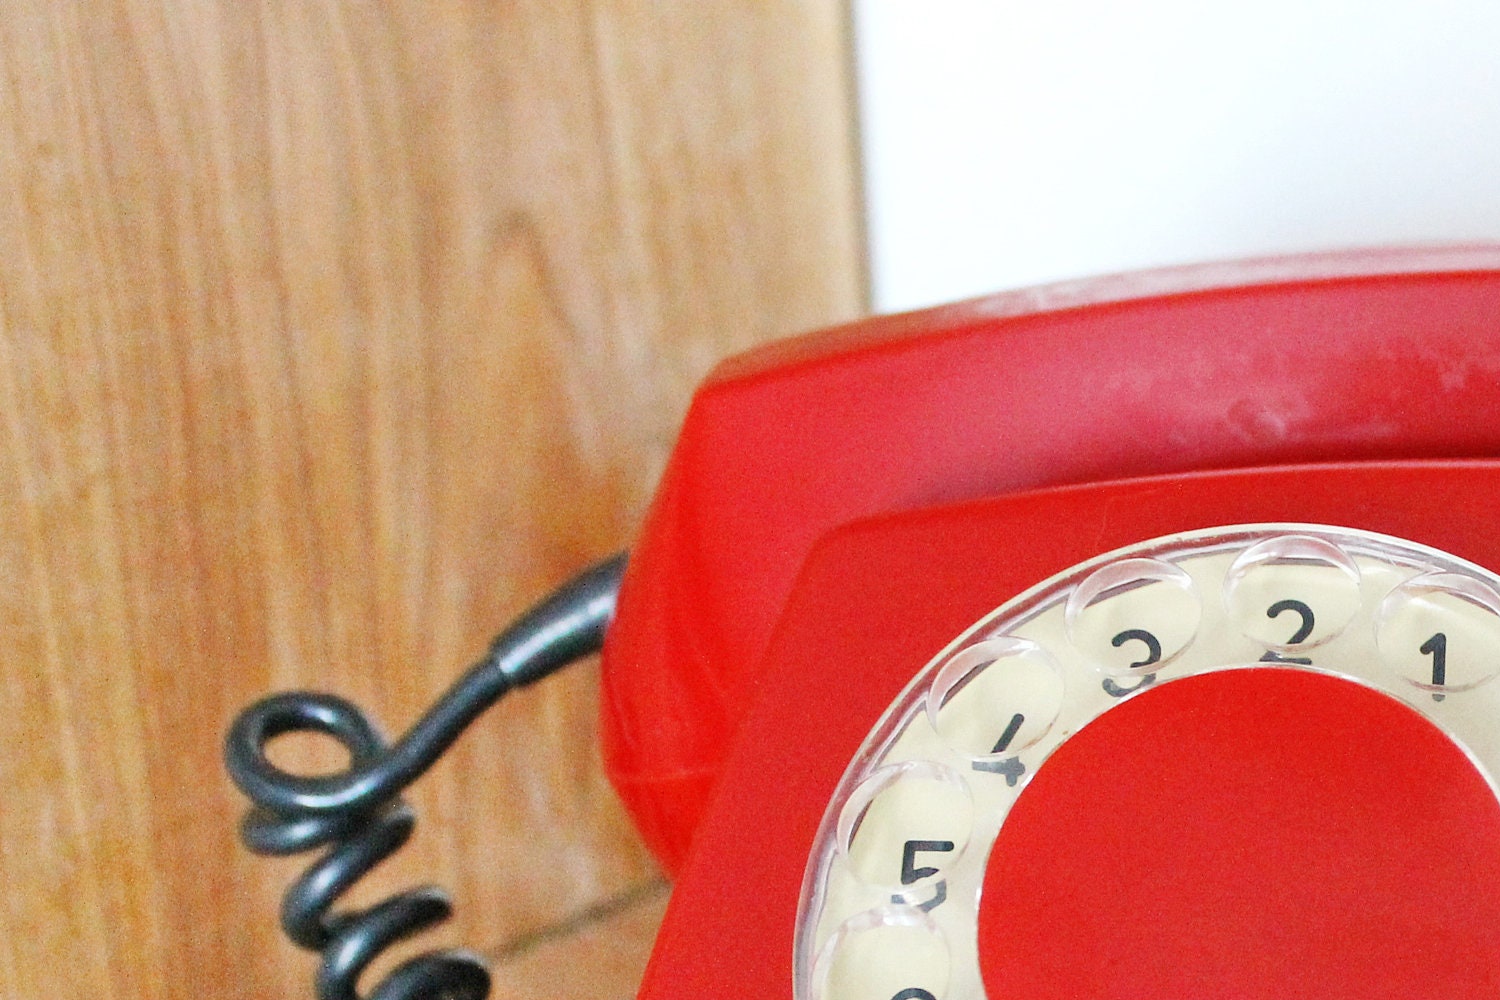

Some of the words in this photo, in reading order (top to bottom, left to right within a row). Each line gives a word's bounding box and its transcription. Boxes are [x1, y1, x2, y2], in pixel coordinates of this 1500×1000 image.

[1101, 629, 1161, 697] 3
[1259, 599, 1315, 664] 2
[1419, 632, 1447, 702] 1
[972, 713, 1026, 787] 4
[891, 840, 954, 912] 5
